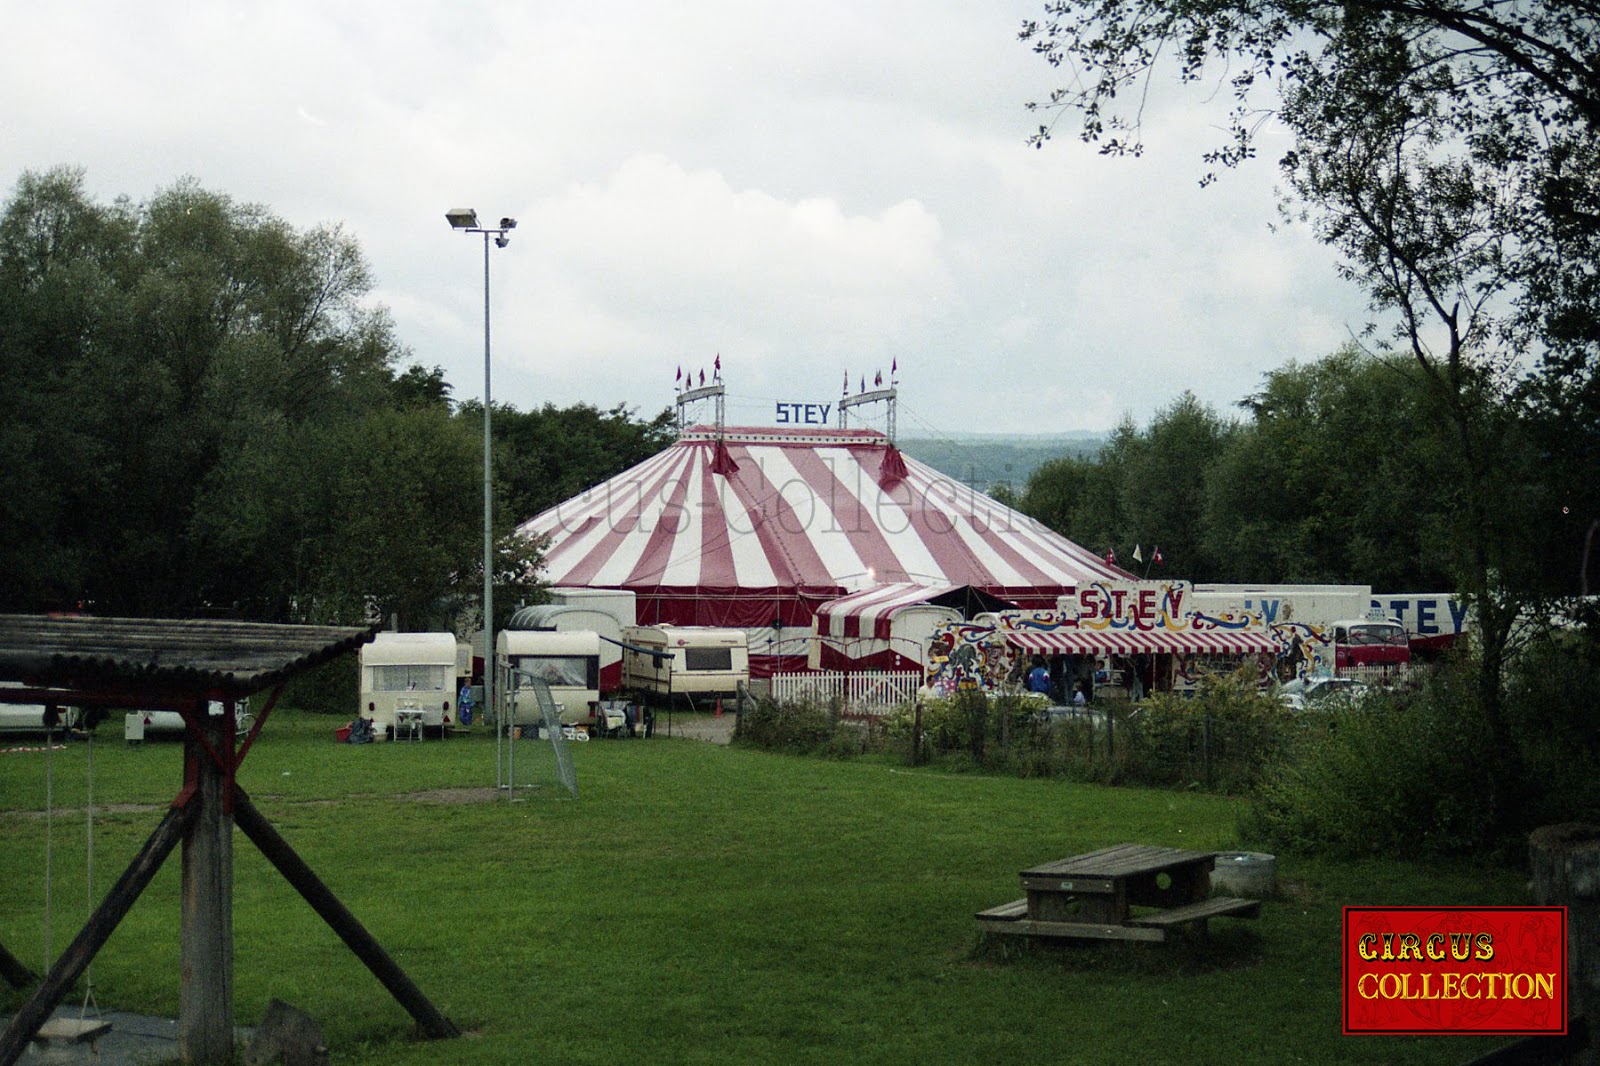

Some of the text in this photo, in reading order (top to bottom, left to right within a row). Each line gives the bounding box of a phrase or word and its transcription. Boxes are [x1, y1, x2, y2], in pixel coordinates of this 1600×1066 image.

[776, 402, 831, 424] STEY
[1080, 589, 1184, 619] STEY
[1371, 600, 1468, 634] TEY
